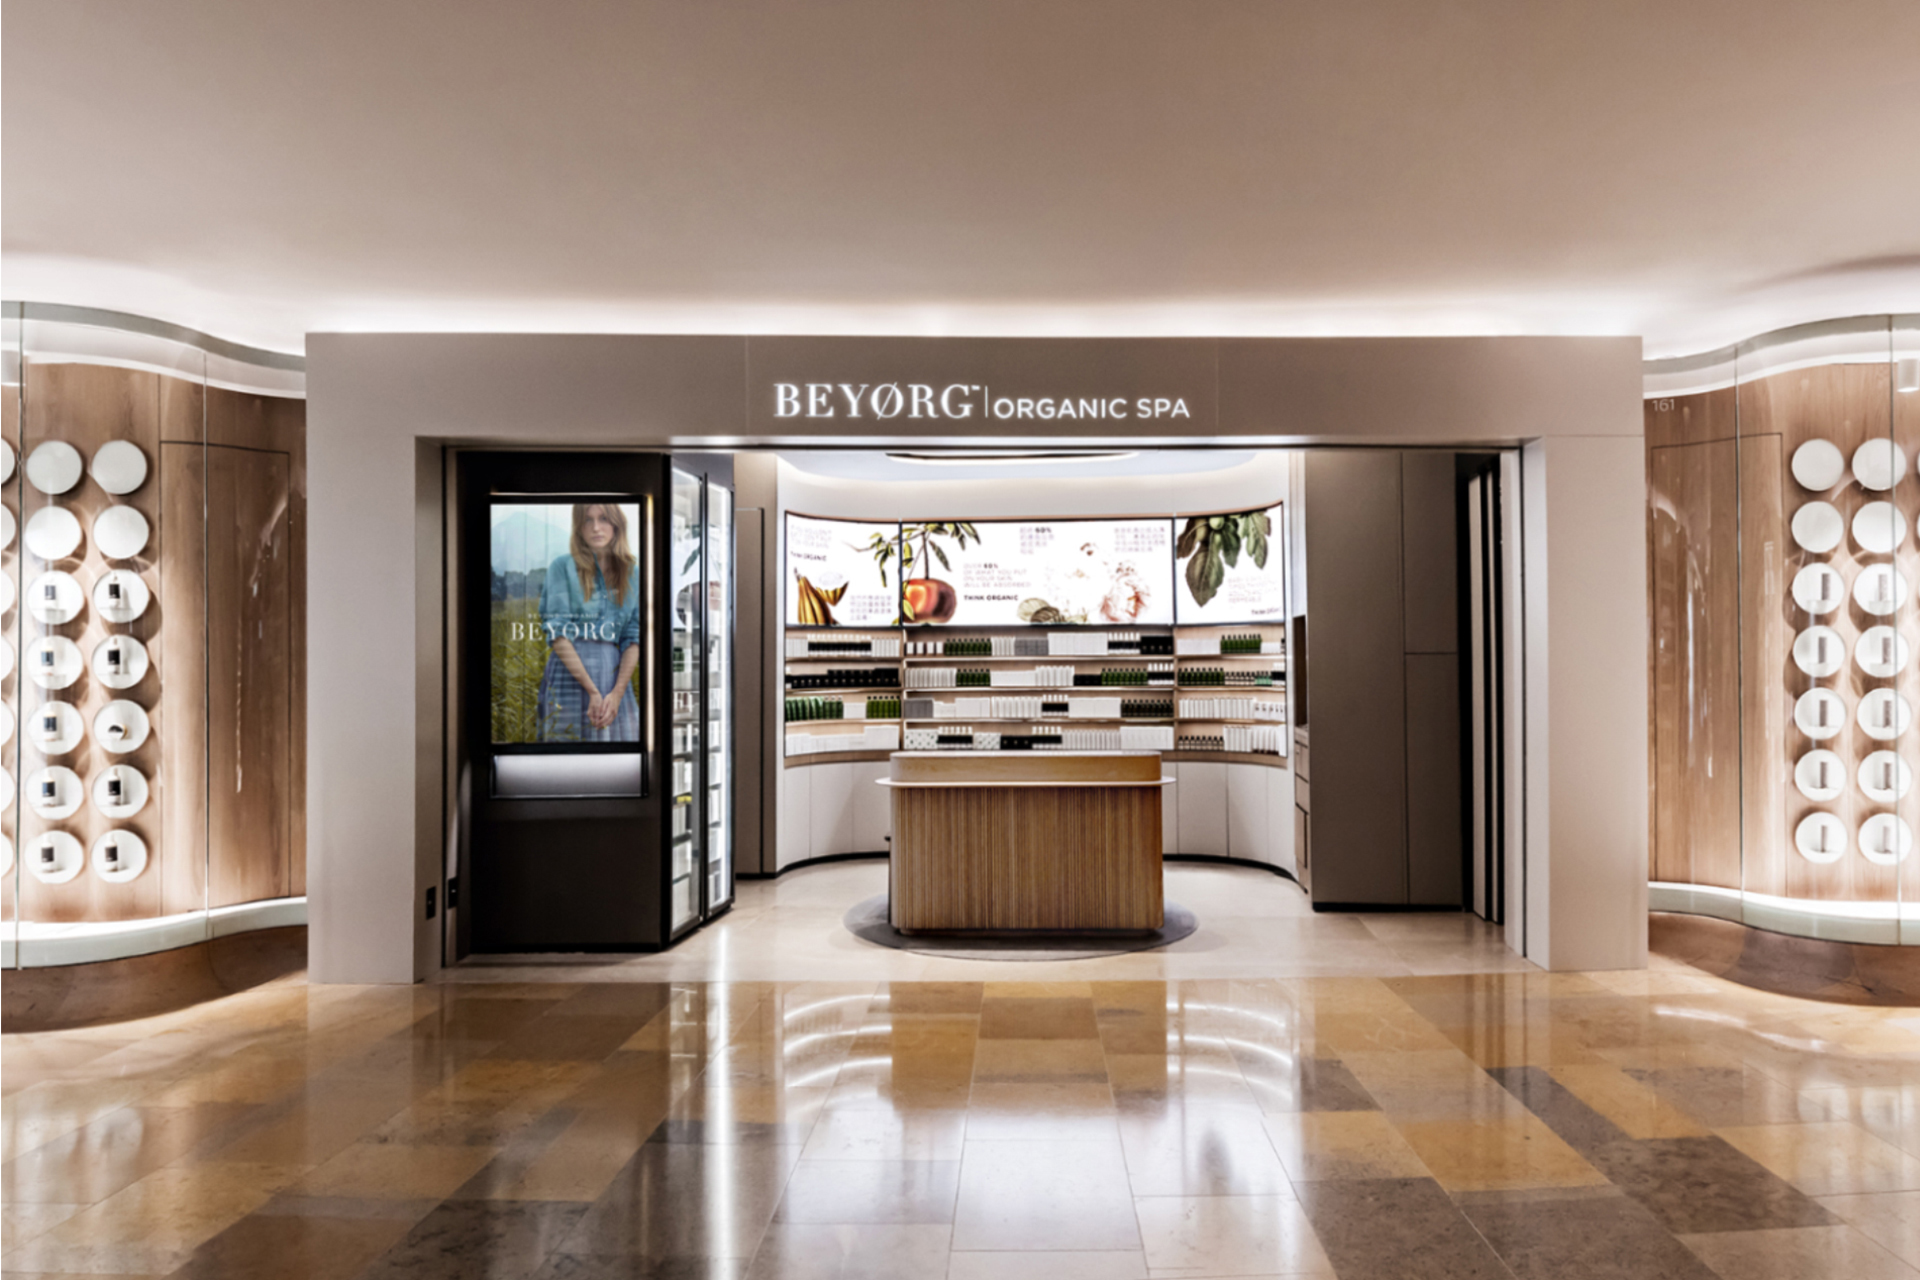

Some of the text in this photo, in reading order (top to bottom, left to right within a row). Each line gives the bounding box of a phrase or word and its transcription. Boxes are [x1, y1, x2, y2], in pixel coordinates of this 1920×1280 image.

[994, 398, 1127, 419] ORGANIC
[1137, 398, 1190, 419] SPA
[1652, 399, 1675, 412] 161
